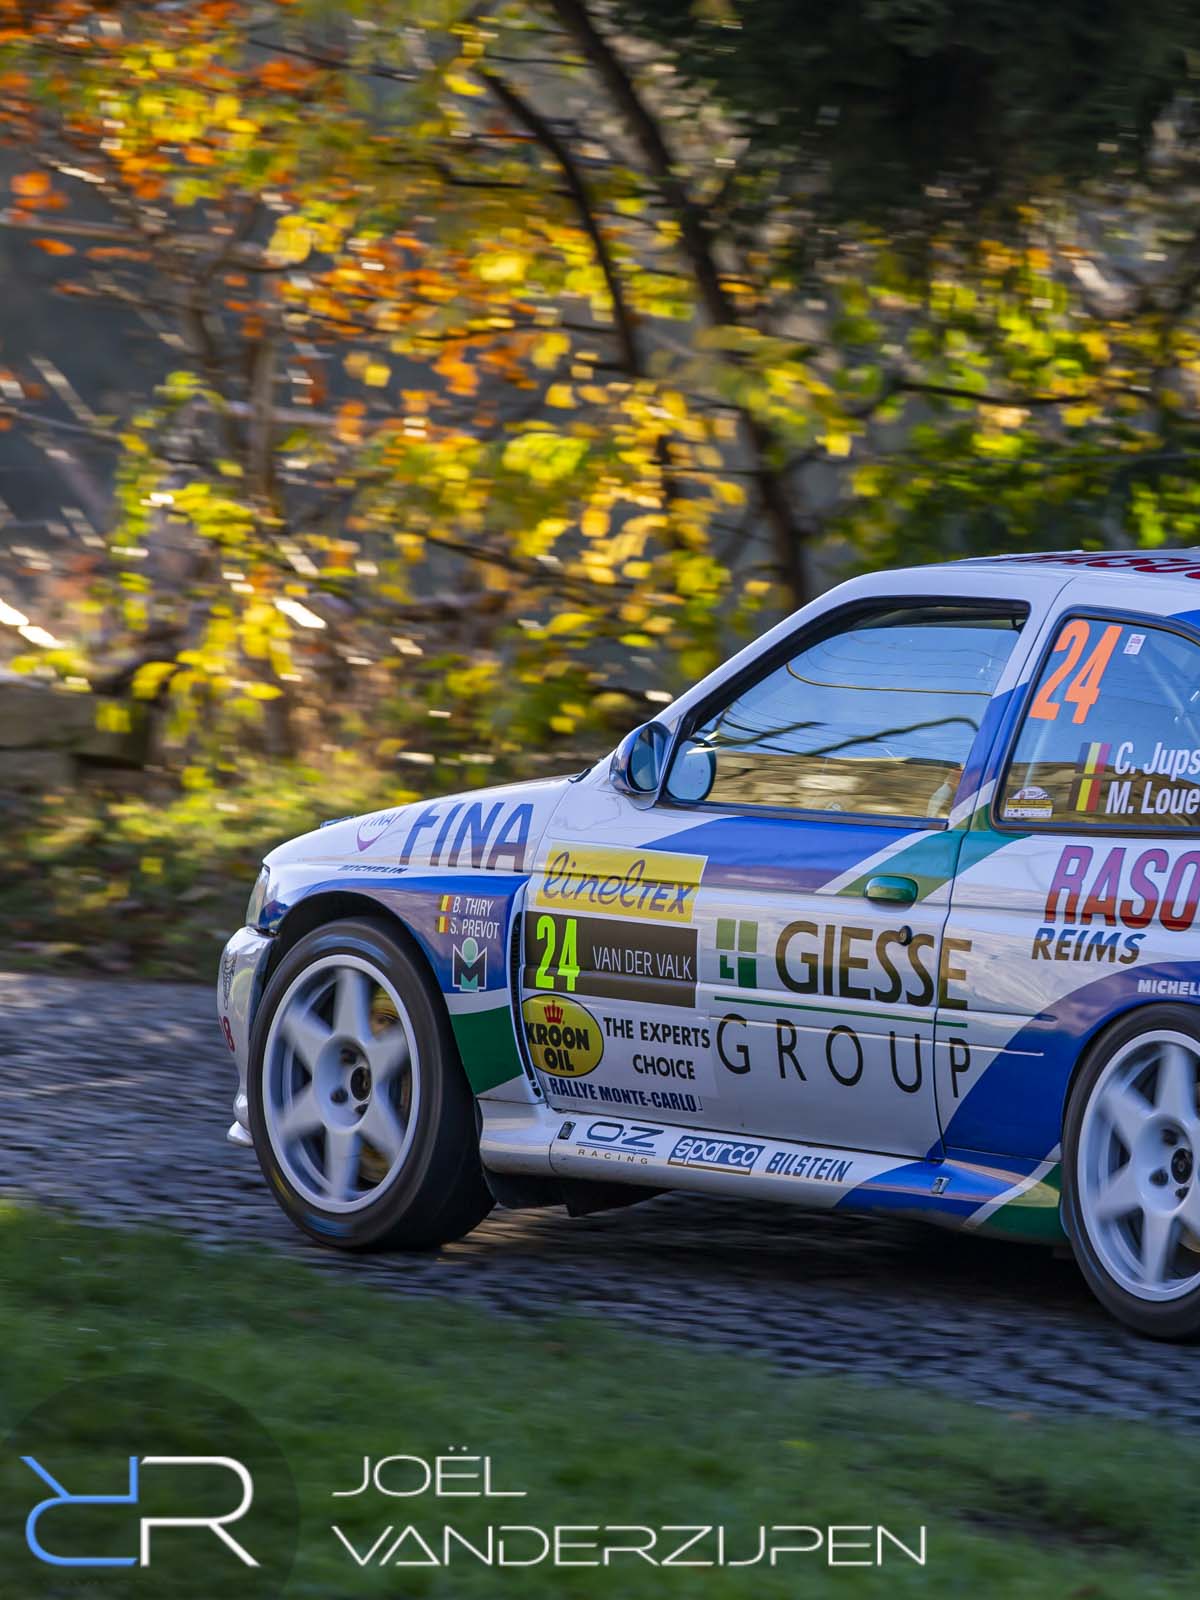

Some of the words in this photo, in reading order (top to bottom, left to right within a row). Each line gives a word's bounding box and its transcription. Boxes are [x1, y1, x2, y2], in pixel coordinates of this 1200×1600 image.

[1028, 620, 1124, 724] 24
[1115, 741, 1136, 774] C.
[1105, 781, 1133, 814] M.
[399, 802, 534, 873] FINA
[453, 896, 461, 913] B.
[465, 898, 494, 917] THIRY
[462, 919, 500, 939] PREVOT
[1031, 927, 1147, 964] REIMS
[535, 915, 580, 992] 24
[592, 945, 621, 973] VAN
[625, 949, 653, 976] DER
[656, 953, 693, 980] VALK
[775, 920, 972, 1011] GIESSE
[526, 1022, 590, 1051] KROON
[603, 1017, 634, 1039] THE
[640, 1022, 711, 1048] EXPERTS
[544, 1047, 575, 1071] OIL
[633, 1054, 696, 1080] CHOICE
[717, 1013, 971, 1099] GROUP
[549, 1077, 598, 1100] RALLYE
[600, 1086, 697, 1112] MONTE-CARLO
[577, 1149, 648, 1165] RACING
[673, 1136, 760, 1167] sparco
[765, 1151, 853, 1183] BILSTEIN
